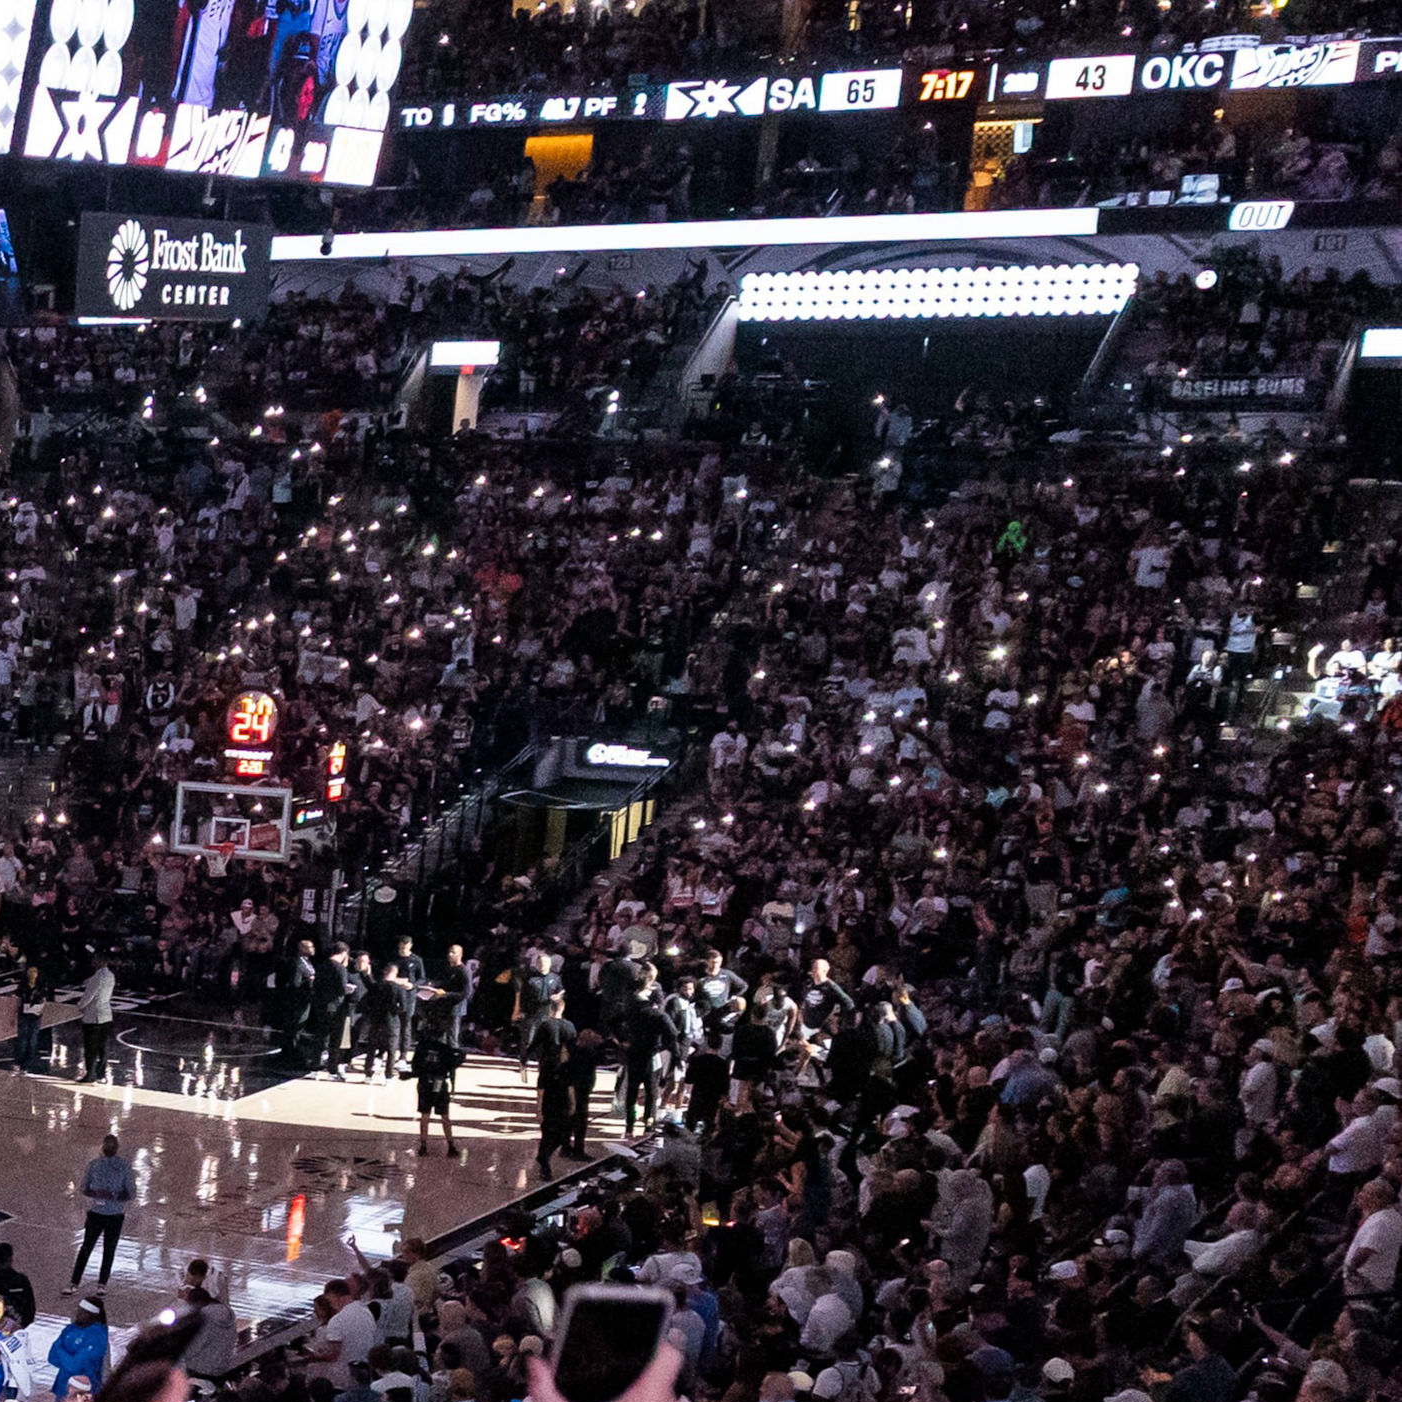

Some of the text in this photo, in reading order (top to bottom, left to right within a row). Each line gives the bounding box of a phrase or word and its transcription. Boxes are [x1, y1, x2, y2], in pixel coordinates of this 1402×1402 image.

[919, 70, 974, 101] 7:17
[1075, 64, 1107, 92] 43
[1140, 52, 1225, 90] OKC
[584, 96, 617, 117] PF
[768, 77, 876, 111] SA 65
[469, 102, 527, 124] FG%
[1238, 204, 1286, 228] OUT
[151, 229, 247, 273] Frost Bank
[161, 284, 230, 306] CENTER
[1171, 378, 1306, 397] BASELINE BUMS
[232, 711, 270, 742] 24
